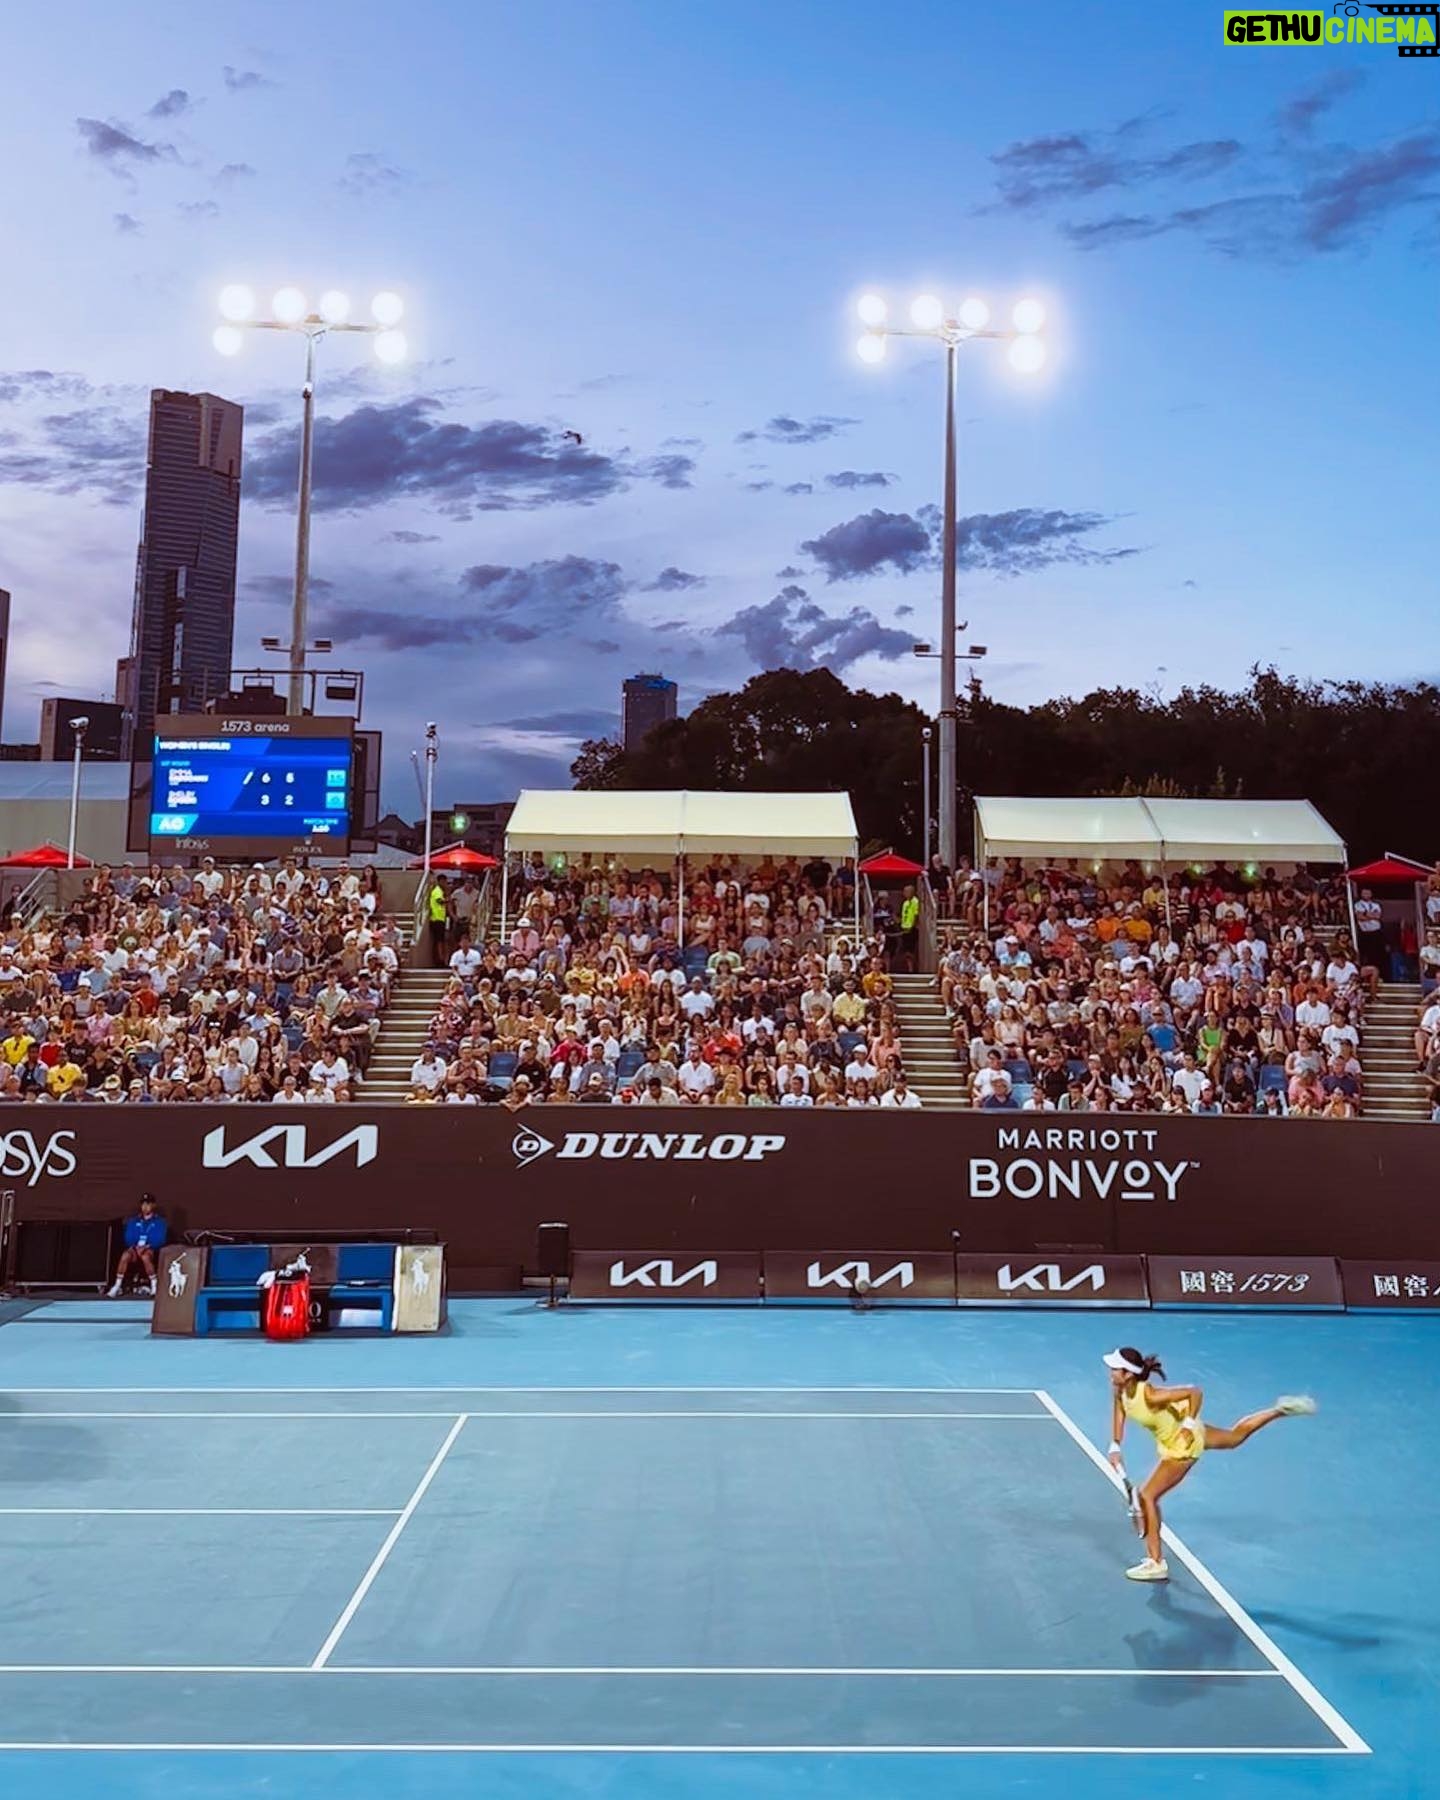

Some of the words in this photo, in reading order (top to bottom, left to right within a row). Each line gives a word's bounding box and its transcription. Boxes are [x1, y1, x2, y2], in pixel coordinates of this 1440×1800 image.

[221, 720, 252, 732] 1573
[254, 723, 290, 732] arena
[261, 772, 271, 784] 6
[260, 794, 270, 806] 3
[284, 794, 294, 806] 2
[202, 1124, 378, 1168] KIA
[555, 1133, 786, 1160] DUNLOP
[998, 1128, 1158, 1151] MARRIOTT
[0, 1130, 76, 1187] sys
[610, 1260, 717, 1287] KIA
[997, 1264, 1105, 1291] KIA
